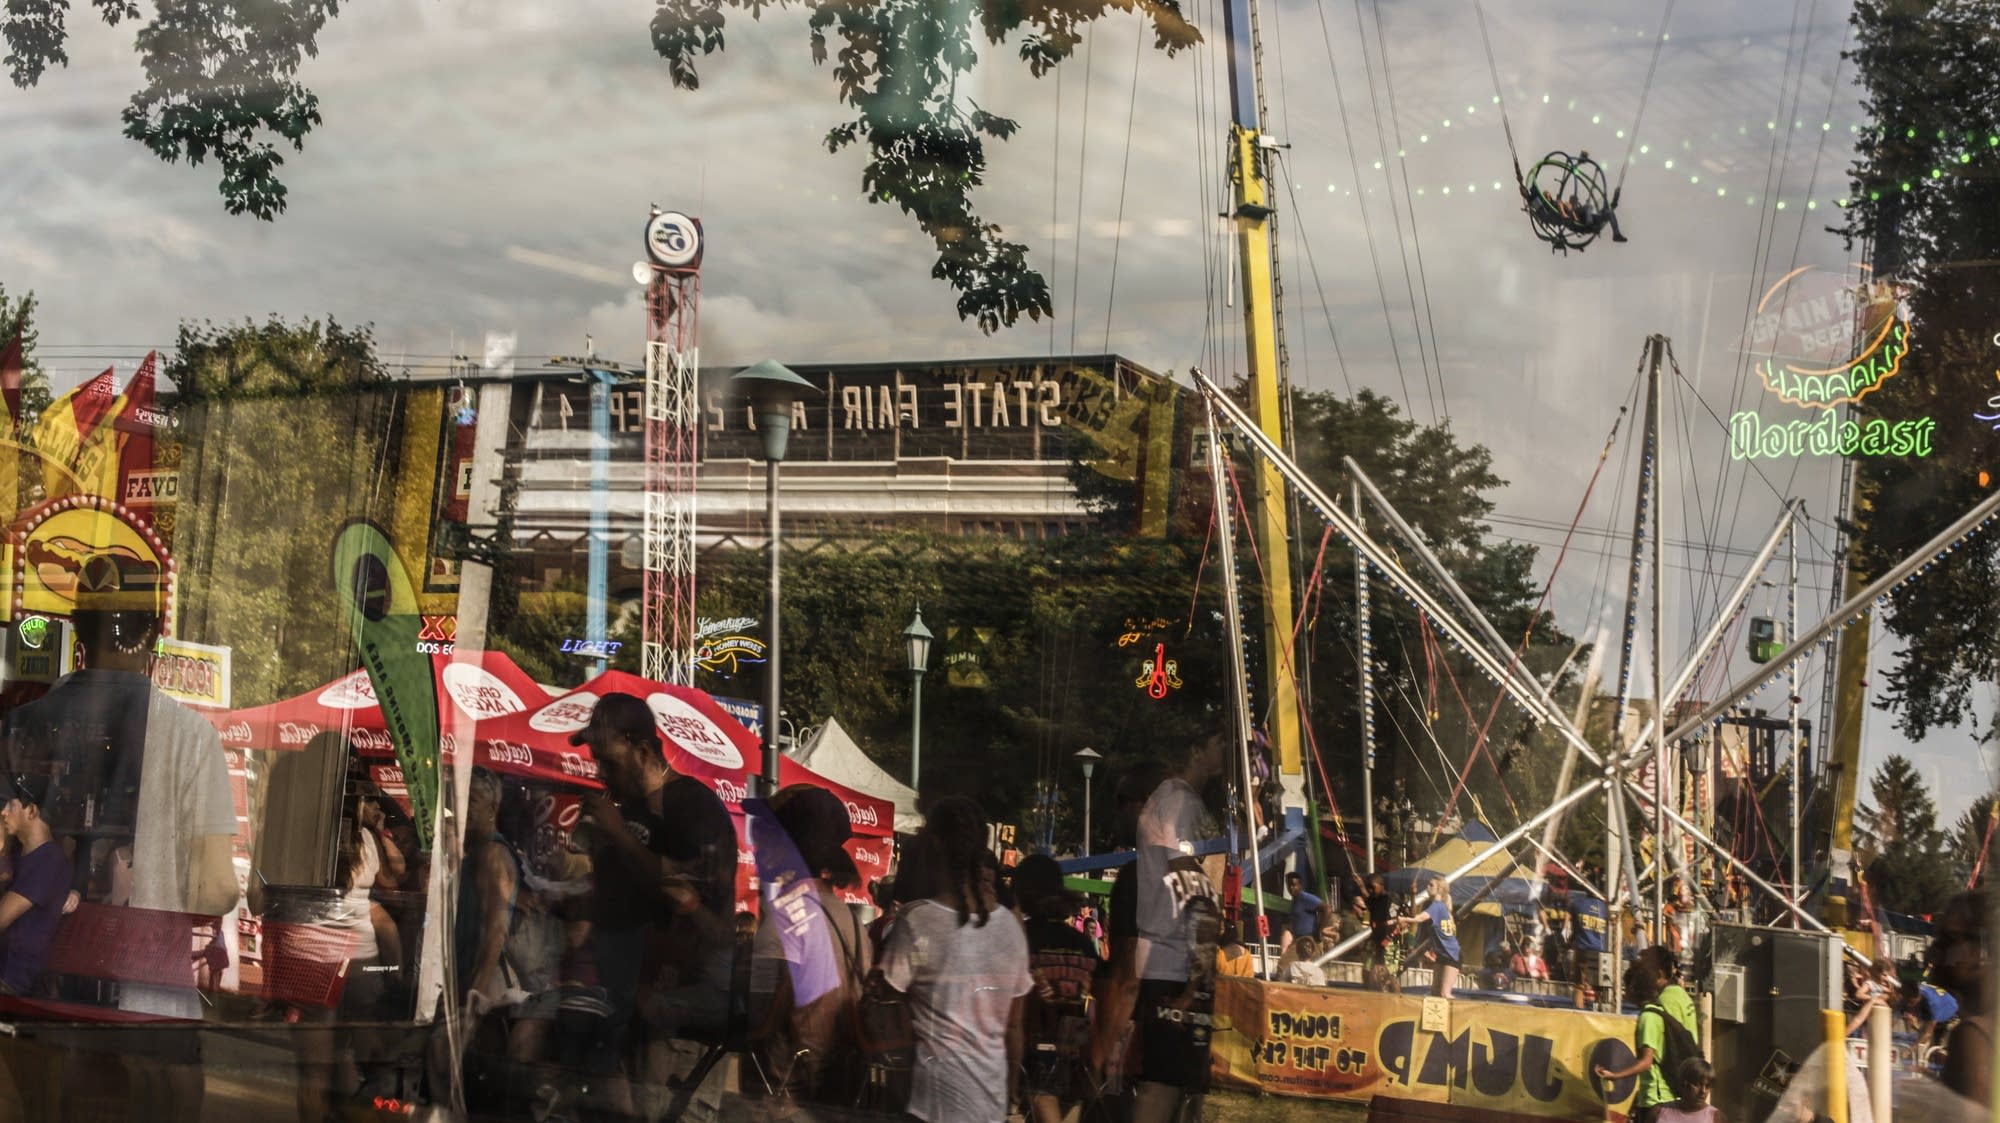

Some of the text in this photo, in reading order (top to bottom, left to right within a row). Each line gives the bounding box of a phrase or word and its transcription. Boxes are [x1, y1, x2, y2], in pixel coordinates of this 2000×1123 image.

[1730, 409, 1936, 461] Nordeast
[416, 641, 440, 655] DOS
[560, 639, 622, 654] LIGHT
